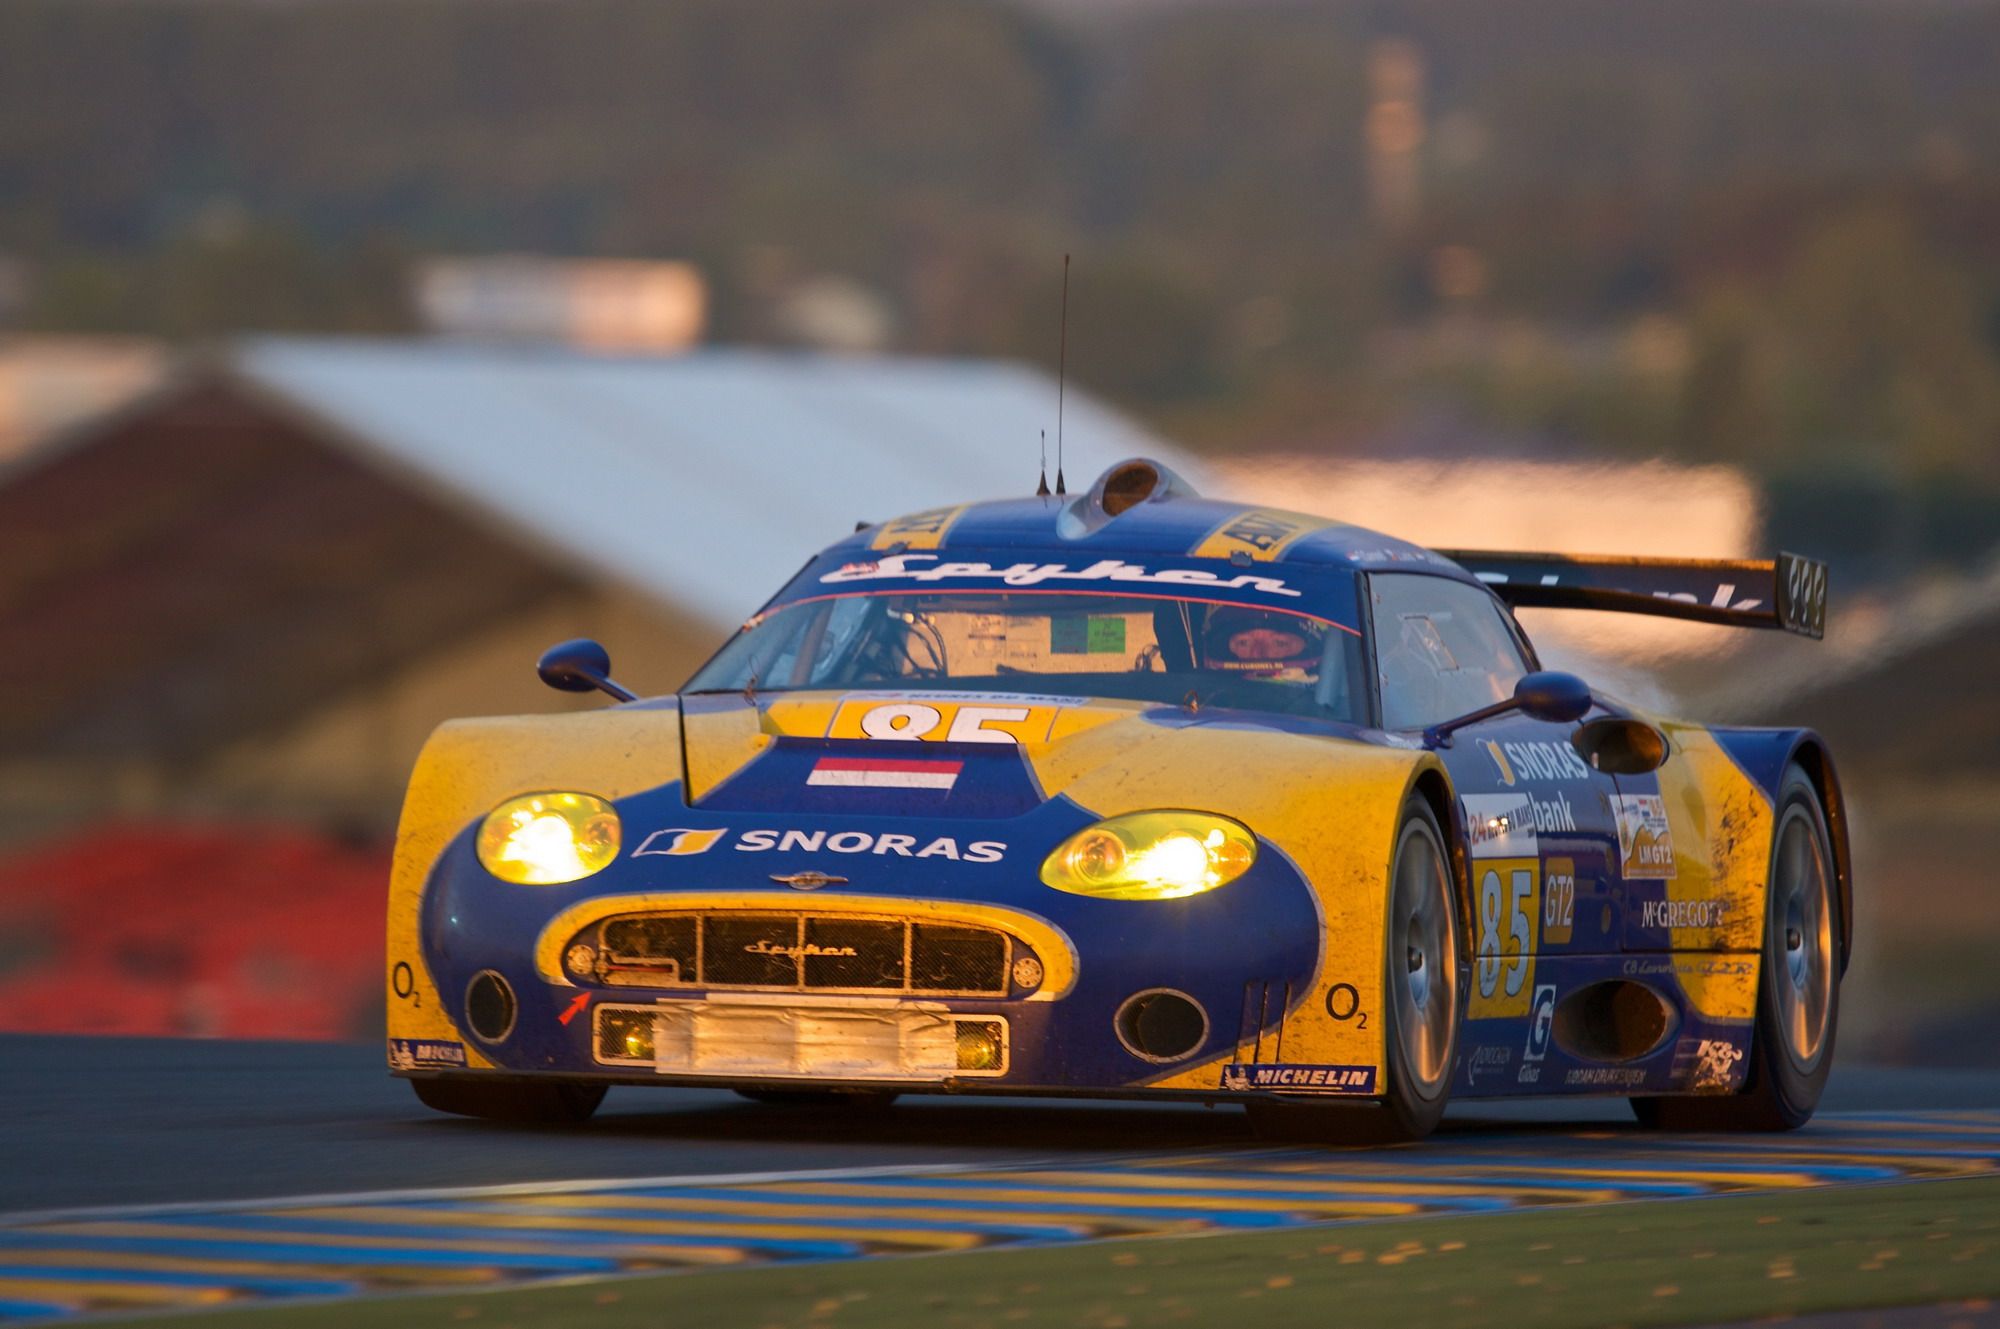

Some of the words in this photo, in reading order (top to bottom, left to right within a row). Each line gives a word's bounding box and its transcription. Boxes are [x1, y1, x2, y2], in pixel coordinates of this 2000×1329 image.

[819, 554, 1302, 597] Spyker
[1504, 741, 1589, 779] SNORAS
[1528, 791, 1576, 832] bank
[734, 830, 1008, 864] SNORAS
[1545, 874, 1574, 927] GT2
[1479, 869, 1533, 998] 85
[1253, 1069, 1369, 1086] MICHELIN
